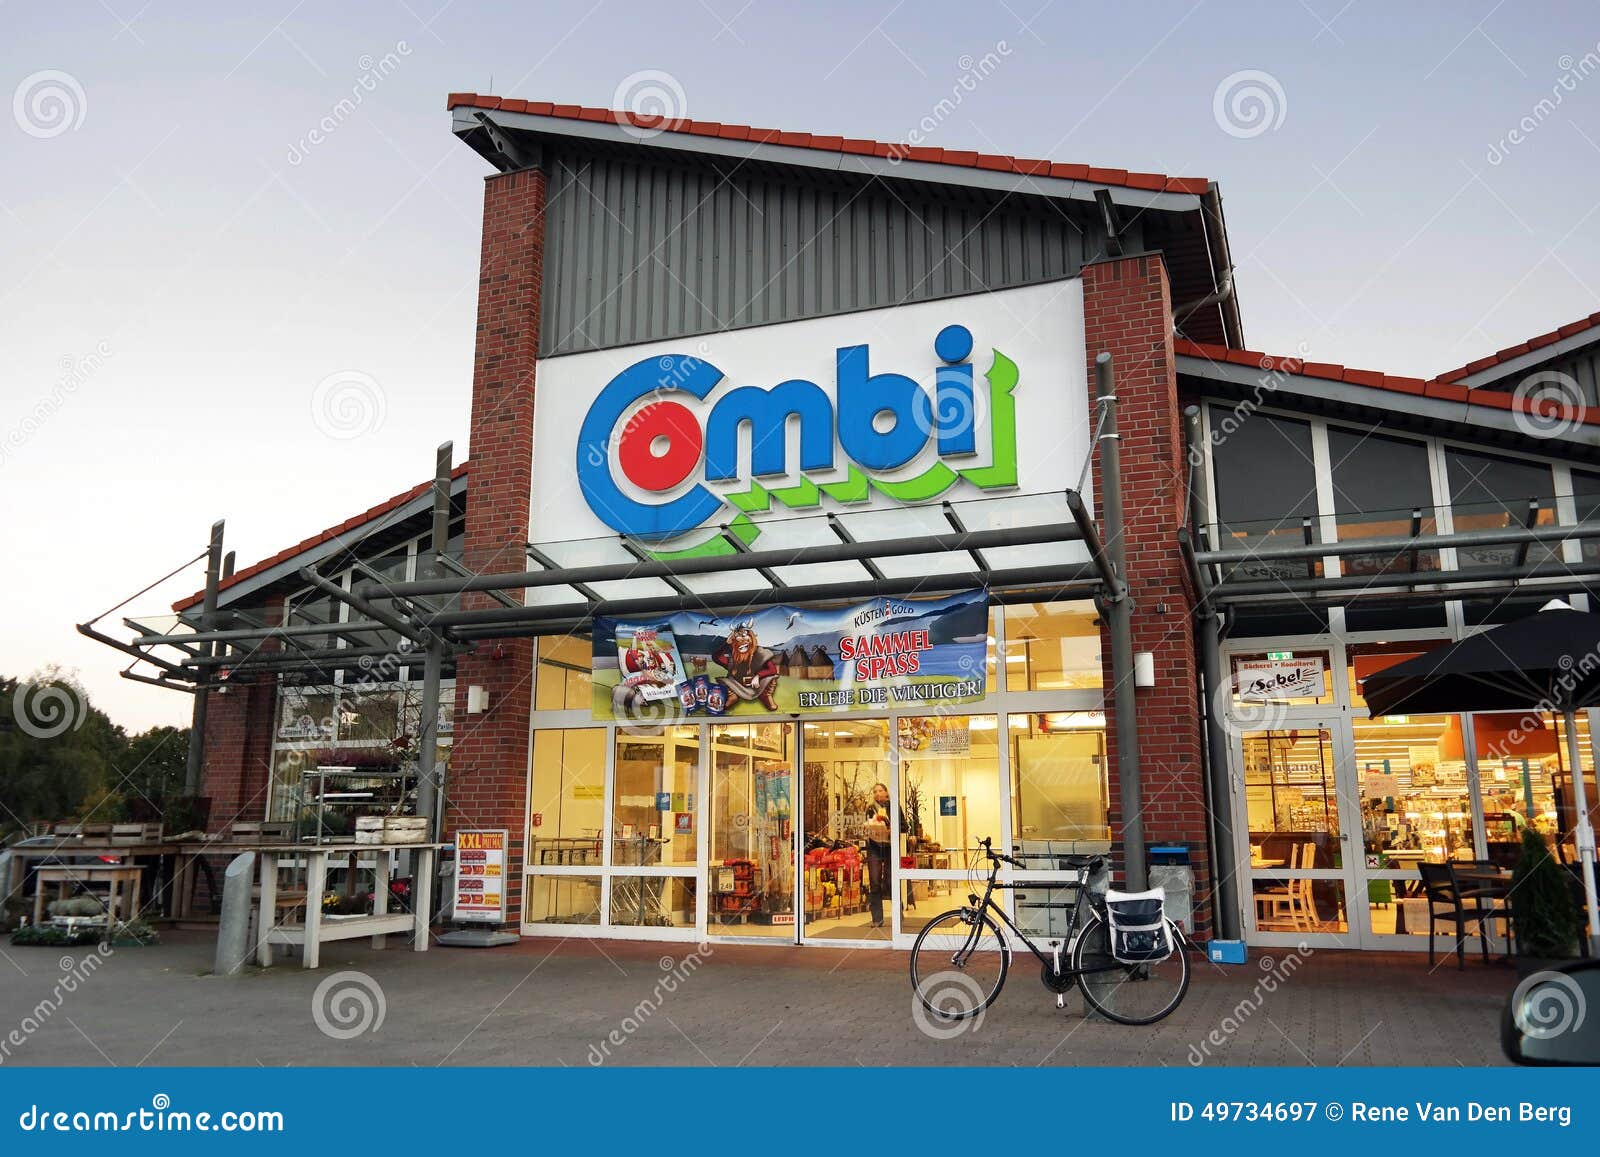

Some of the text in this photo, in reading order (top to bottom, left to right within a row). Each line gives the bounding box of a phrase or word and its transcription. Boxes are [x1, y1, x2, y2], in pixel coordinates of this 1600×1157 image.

[576, 324, 977, 541] Combi
[854, 604, 914, 628] KÜSTEN GOLD
[840, 629, 933, 661] SAMMEL
[856, 652, 920, 682] SPASS
[1255, 668, 1302, 692] Sabel
[799, 681, 982, 707] ERLEBE DIE WIKINGER!
[460, 833, 481, 849] XXL
